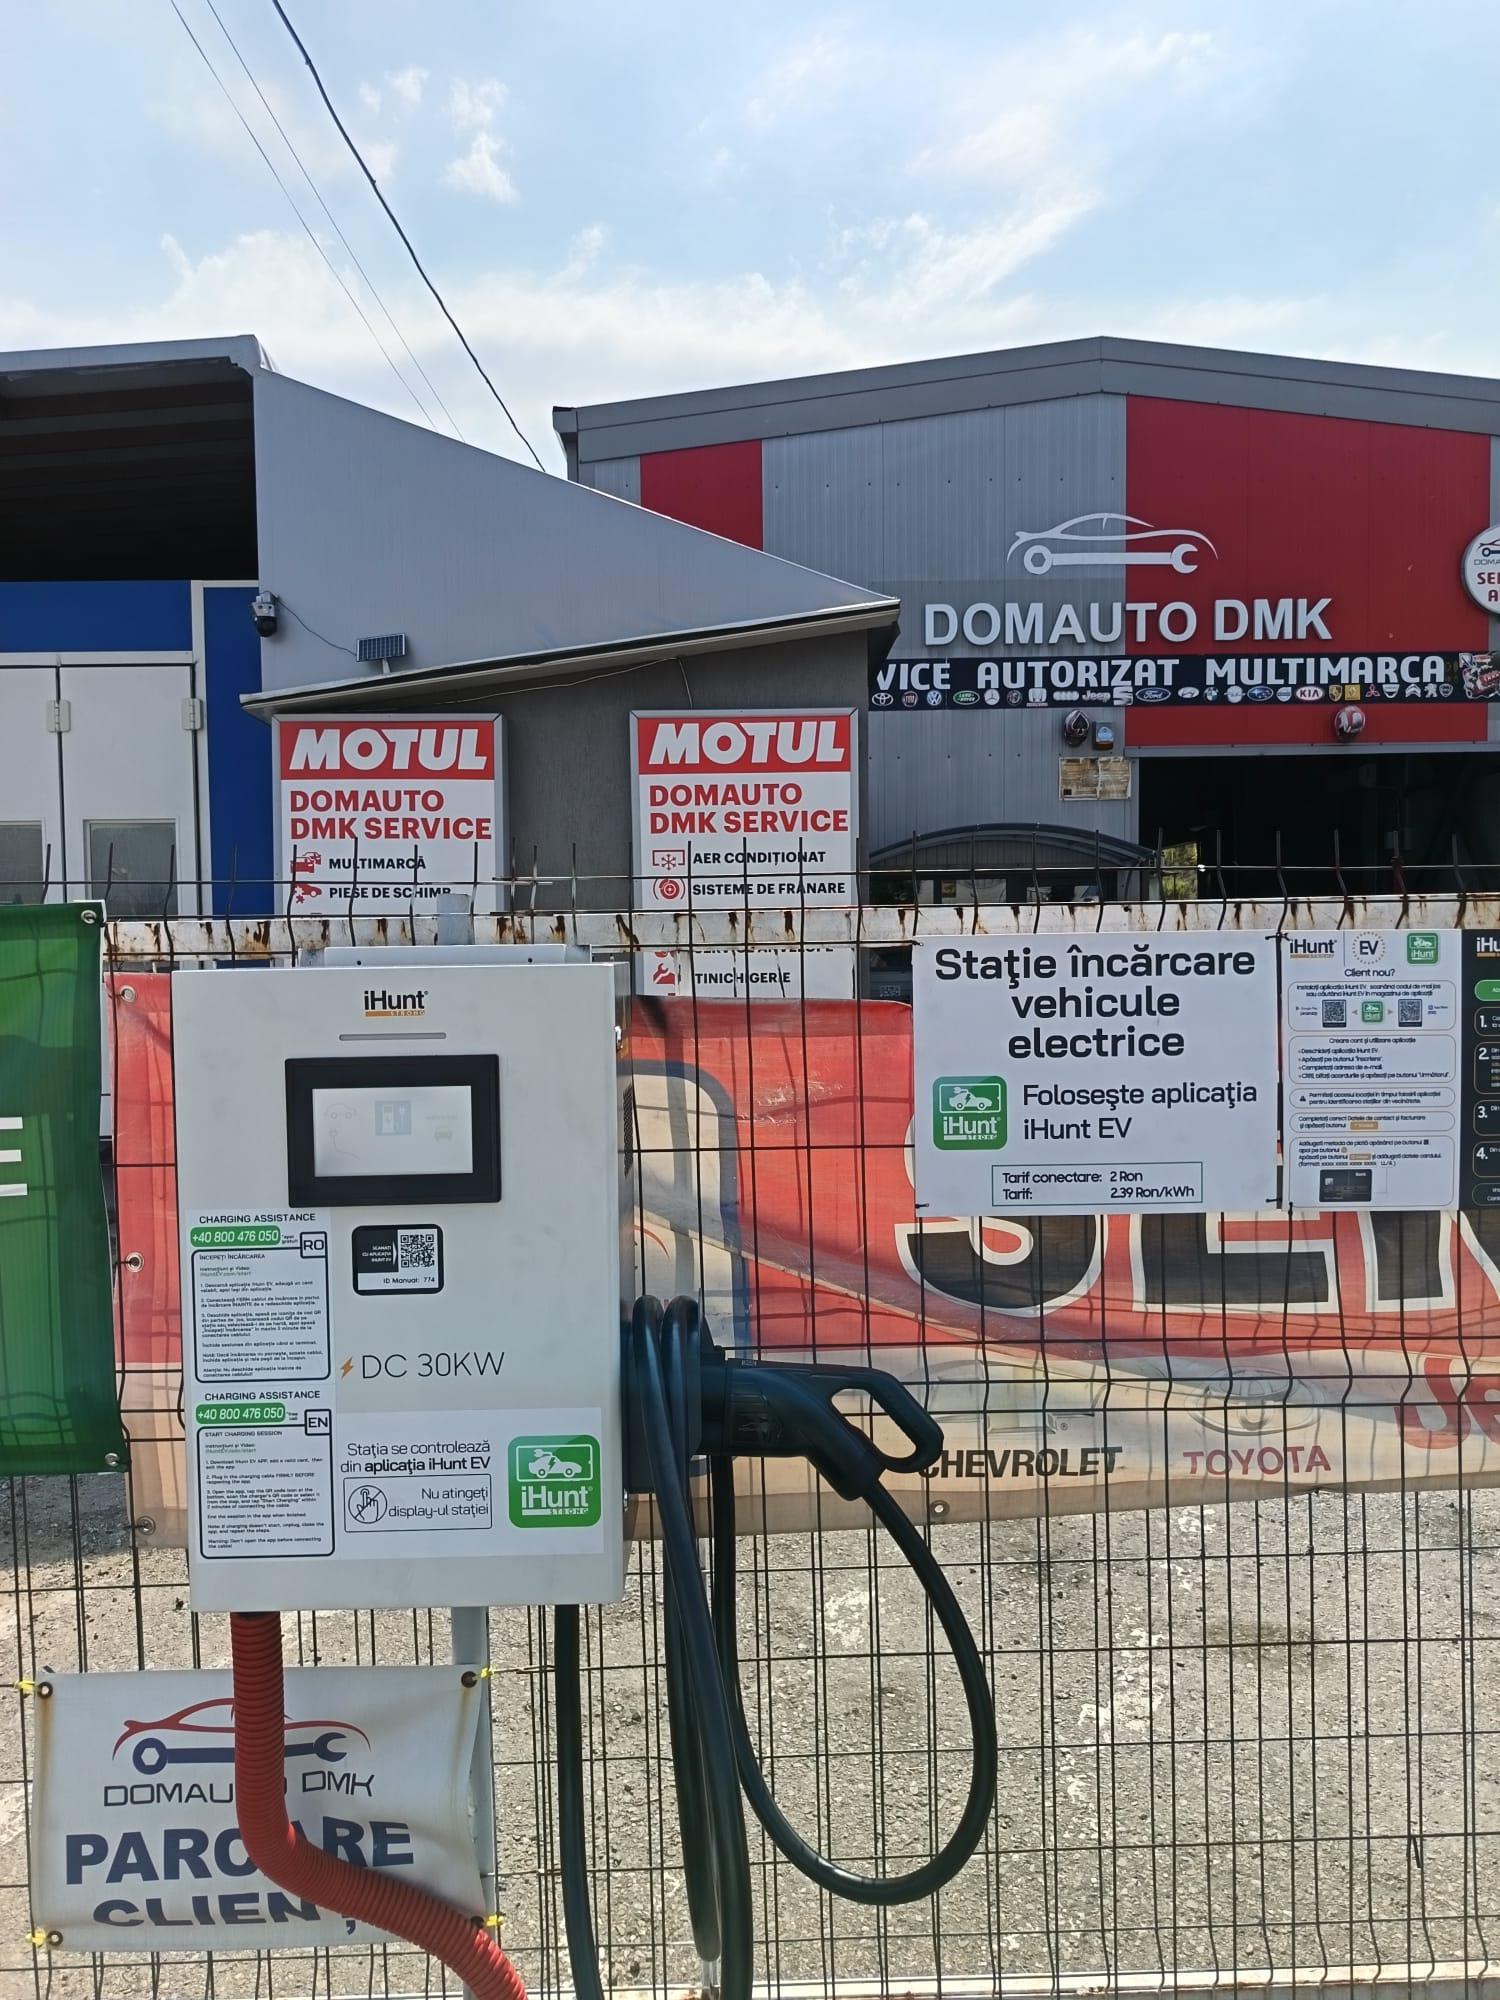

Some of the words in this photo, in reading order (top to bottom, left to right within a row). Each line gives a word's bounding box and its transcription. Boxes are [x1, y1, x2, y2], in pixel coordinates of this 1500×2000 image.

[1477, 572, 1500, 585] SE
[924, 602, 1197, 646] DOMAUTO
[1214, 598, 1333, 642] DMK
[977, 659, 1180, 690] AUTORIZAT
[1205, 655, 1444, 686] MULTIMARCA
[1081, 690, 1110, 701] Jeep
[1300, 689, 1320, 699] KIA
[289, 728, 488, 771] MOTUL
[648, 721, 845, 765] MOTUL
[290, 790, 445, 812] DOMAUTO
[649, 783, 803, 807] DOMAUTO
[290, 817, 358, 840] DMK
[364, 817, 492, 840] SERVICE
[650, 811, 718, 834] DMK
[723, 810, 849, 833] SERVICE
[693, 852, 721, 864] AER
[329, 887, 369, 899] PIESE
[371, 887, 390, 898] DE
[692, 884, 753, 896] SISTEME
[757, 883, 775, 895] DE
[1289, 939, 1335, 954] iHunt
[1359, 940, 1379, 956] EV
[935, 947, 1057, 990] Staţie
[1067, 944, 1256, 978] încărcare
[1344, 969, 1371, 977] Client
[1372, 969, 1395, 978] nou?
[364, 990, 425, 1010] iHunt
[1011, 985, 1180, 1019] vehicule
[1479, 1015, 1487, 1028] 1.
[1008, 1025, 1185, 1059] electrice
[1023, 1084, 1144, 1111] Foloseşte
[1151, 1081, 1257, 1109] aplicaţia
[1477, 1105, 1488, 1119] 3.
[942, 1117, 998, 1136] iHunt
[1024, 1118, 1091, 1140] iHunt
[1098, 1117, 1132, 1139] EV
[1476, 1147, 1488, 1160] 4.
[1003, 1171, 1030, 1184] Tarif
[1032, 1171, 1103, 1184] conectare:
[1110, 1171, 1117, 1182] 2
[1119, 1171, 1143, 1182] Ron
[1003, 1188, 1033, 1200] Tarif:
[1110, 1187, 1134, 1199] 2.39
[1136, 1186, 1195, 1199] Ron/kWh
[199, 1215, 251, 1224] CHARGING
[254, 1213, 316, 1222] ASSISTANCE
[193, 1231, 212, 1243] +40
[214, 1231, 235, 1242] 800
[237, 1230, 256, 1242] 476
[258, 1230, 279, 1241] 050
[303, 1239, 324, 1251] RO
[362, 1354, 408, 1379] DC
[417, 1351, 505, 1377] 30KW
[205, 1392, 256, 1401] CHARGING
[258, 1390, 321, 1400] ASSISTANCE
[198, 1409, 217, 1420] +40
[219, 1408, 240, 1419] 800
[242, 1408, 261, 1419] 476
[263, 1407, 284, 1418] 050
[308, 1417, 329, 1428] EN
[347, 1443, 388, 1459] Staţia
[391, 1445, 408, 1455] se
[410, 1440, 490, 1454] controlează
[340, 1460, 362, 1474] din
[364, 1457, 425, 1475] aplicaţia
[428, 1456, 468, 1470] iHunt
[470, 1456, 491, 1469] EV
[1183, 1445, 1331, 1476] TOYOTA
[421, 1488, 439, 1499] Nu
[442, 1486, 488, 1503] atingeţi
[521, 1485, 589, 1508] iHunt
[388, 1504, 449, 1518] display-ul
[451, 1504, 489, 1518] staţiei
[302, 1770, 375, 1797] DMK
[66, 1816, 414, 1885] PARCRE
